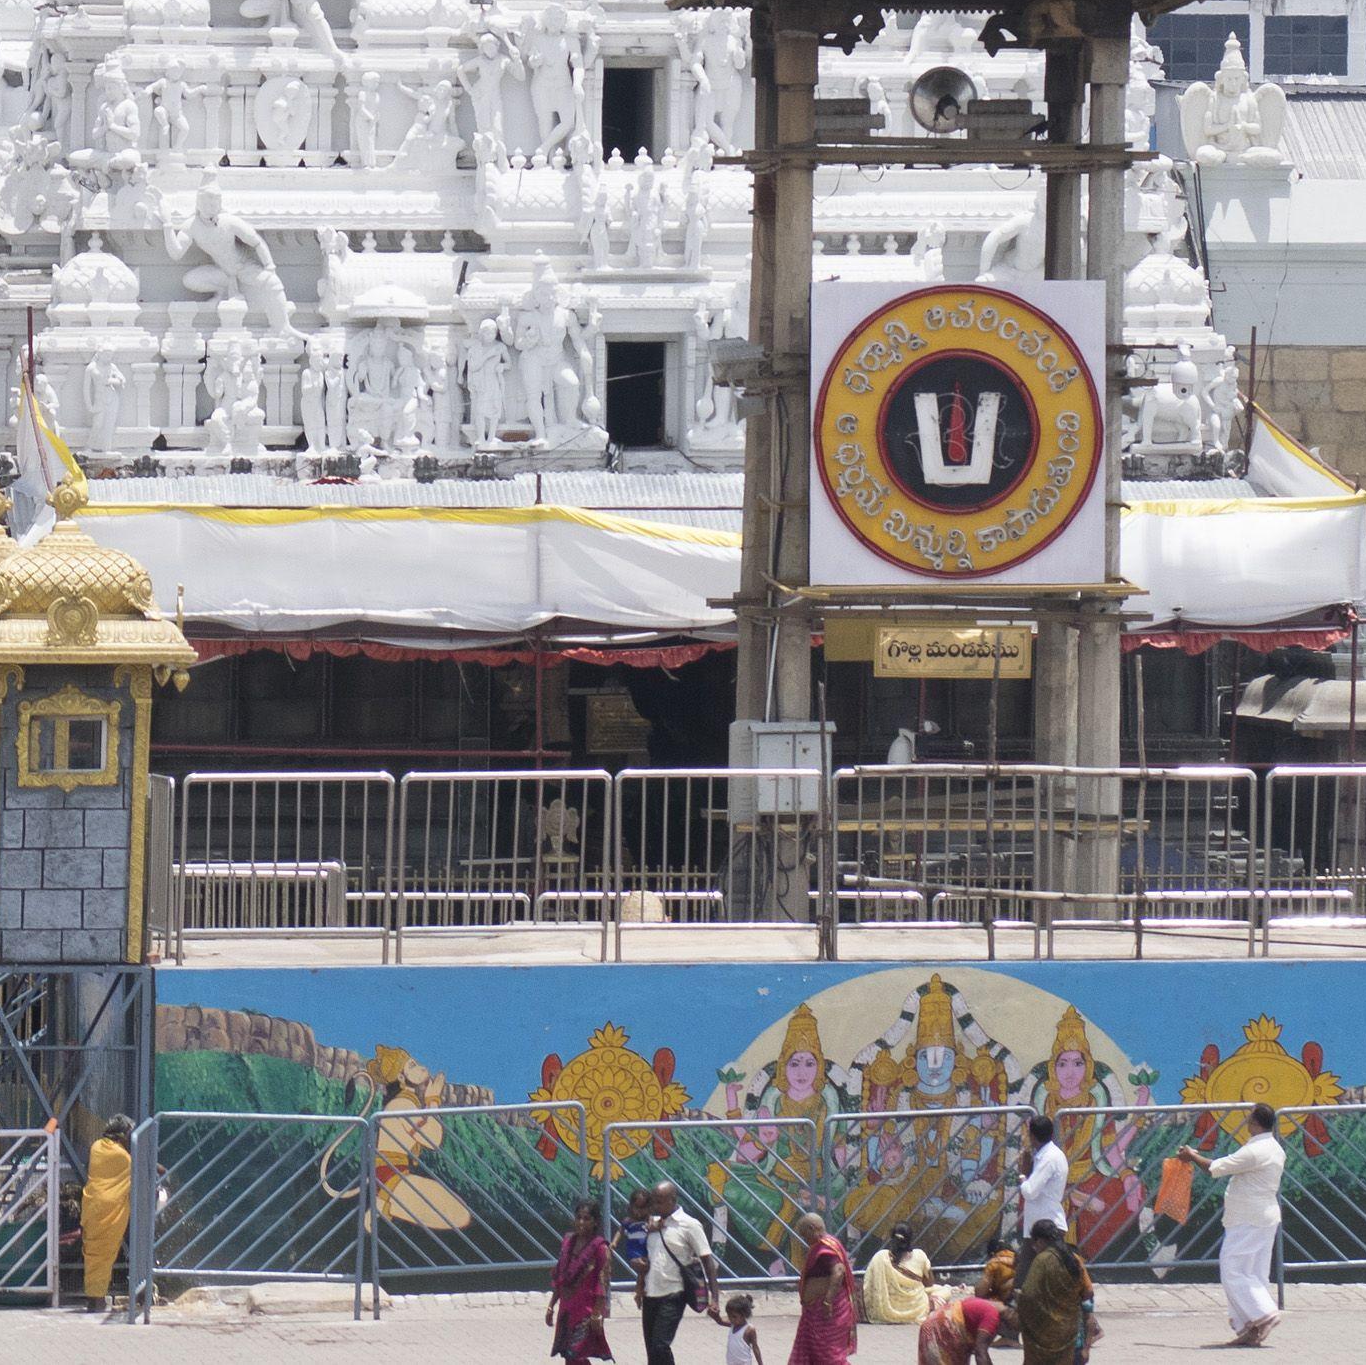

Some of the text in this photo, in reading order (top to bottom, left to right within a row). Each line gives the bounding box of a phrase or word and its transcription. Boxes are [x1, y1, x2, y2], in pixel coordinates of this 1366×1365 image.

[843, 298, 1080, 395] ధర్మాన్ని ఆచరించండి
[832, 441, 891, 516] ధర్మమే
[883, 508, 974, 571] మిమ్మల్ని
[973, 410, 1081, 553] కాపాడుతుంది
[887, 639, 1020, 663] గొల్ల మండపము
